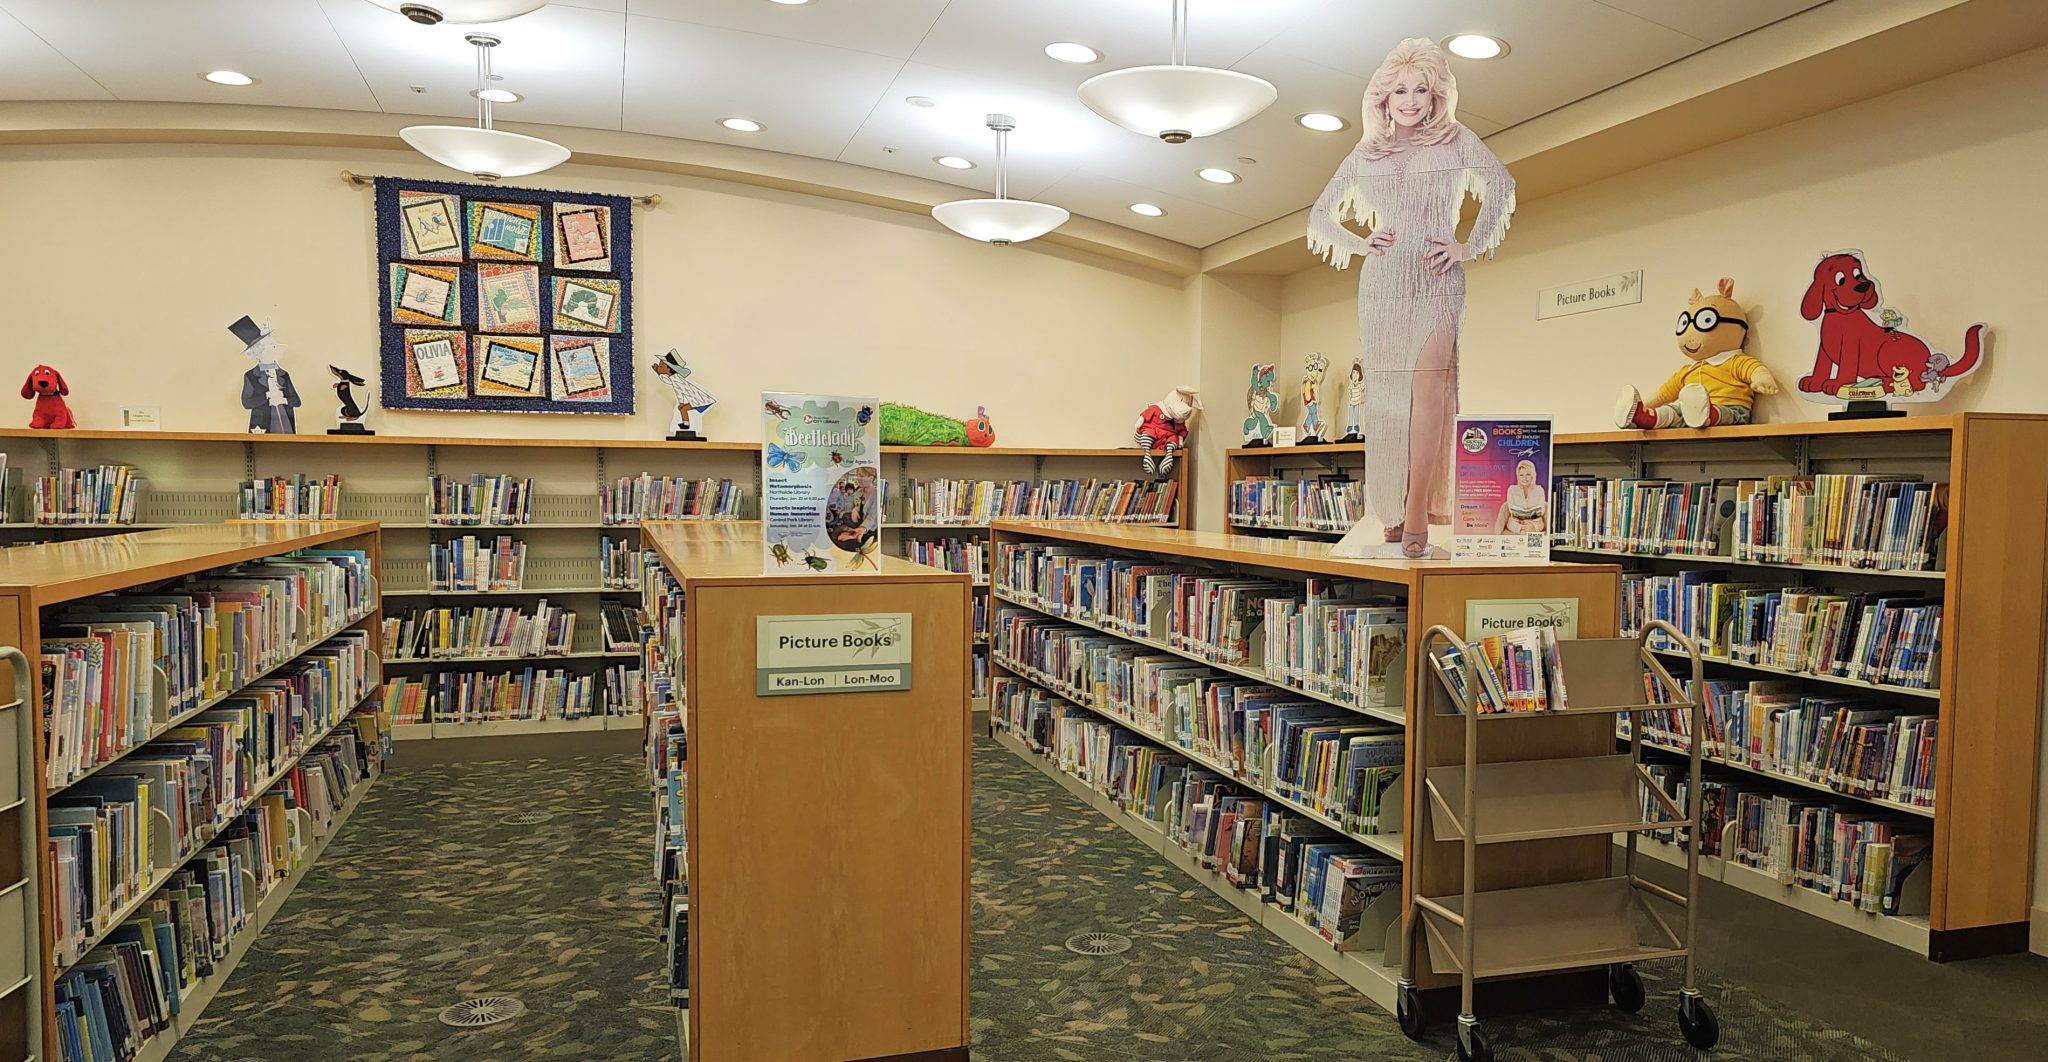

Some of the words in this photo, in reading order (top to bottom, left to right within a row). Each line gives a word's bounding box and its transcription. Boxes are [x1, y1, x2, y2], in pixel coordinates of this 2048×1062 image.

[1556, 293, 1587, 306] Picture
[1589, 284, 1616, 300] Books
[416, 342, 452, 360] OLIVIA
[783, 424, 855, 452] Beetlelady
[1481, 617, 1524, 629] Picture
[1526, 615, 1563, 628] Books
[779, 635, 838, 649] Picture
[842, 633, 892, 648] Books
[776, 676, 825, 687] Kan-Lon
[844, 674, 895, 685] Lon-Moo
[1350, 885, 1373, 906] NOT
[1379, 881, 1397, 891] MY
